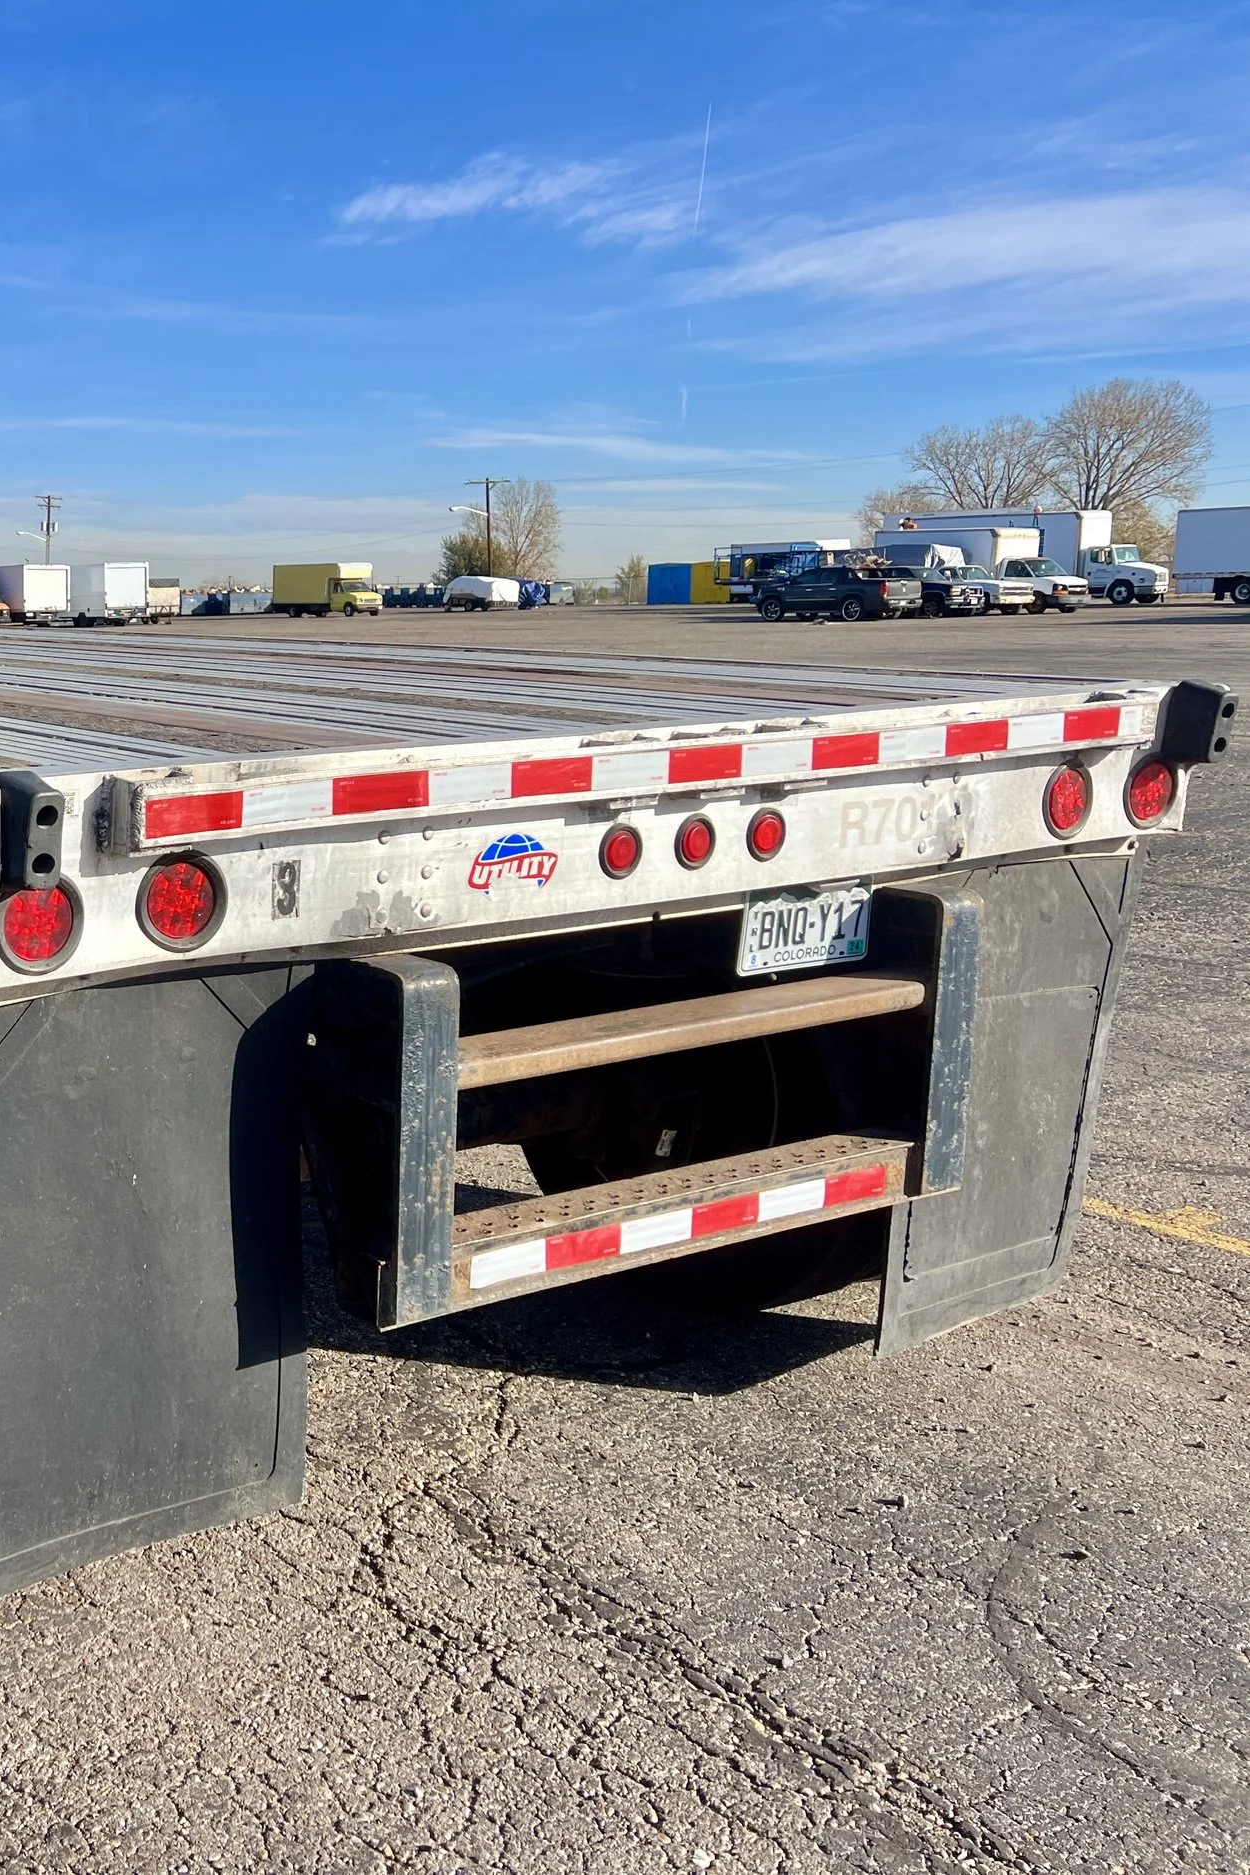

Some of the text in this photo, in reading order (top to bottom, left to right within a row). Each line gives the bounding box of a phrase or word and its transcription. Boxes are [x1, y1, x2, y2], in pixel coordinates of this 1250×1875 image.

[471, 855, 557, 886] UTILITY
[758, 899, 865, 951] BNQ-Y17
[773, 944, 837, 963] COLORADO
